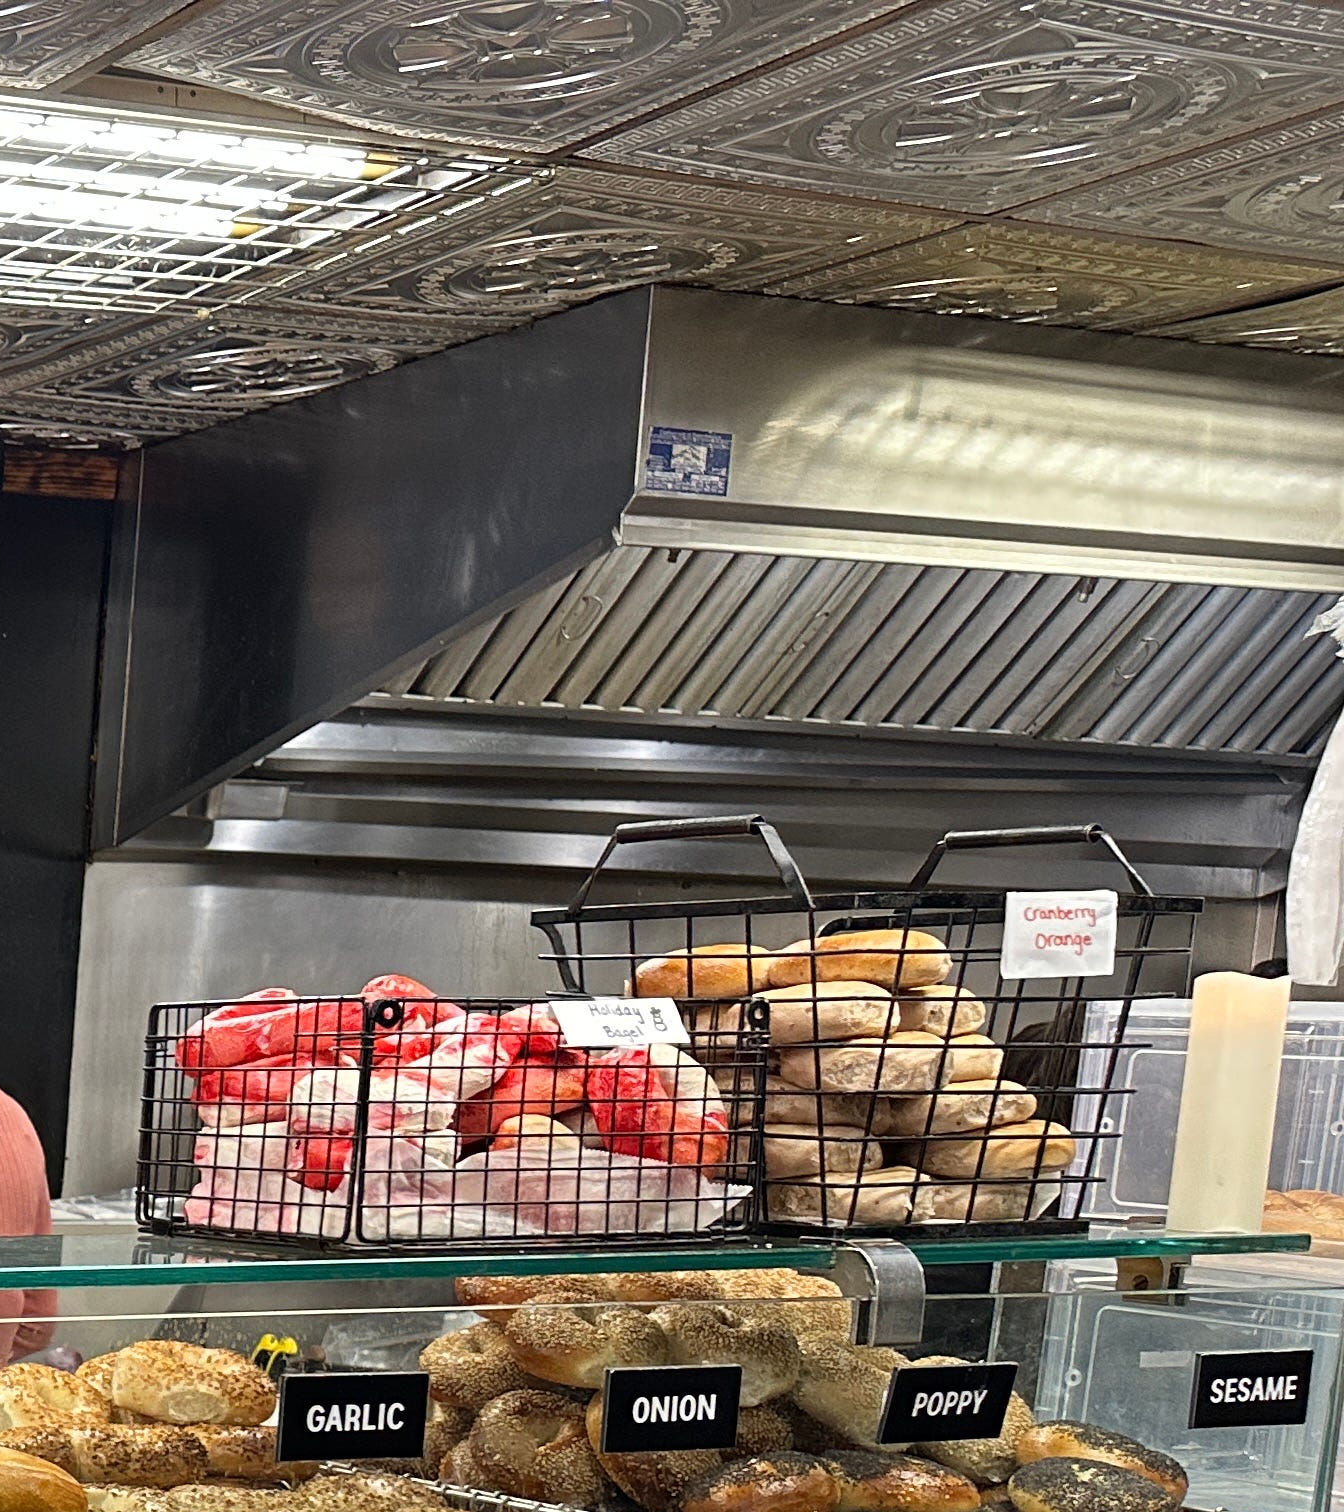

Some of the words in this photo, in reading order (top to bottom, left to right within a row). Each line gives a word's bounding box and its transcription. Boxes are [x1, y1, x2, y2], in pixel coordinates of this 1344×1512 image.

[1023, 906, 1097, 928] Cranberry
[1035, 933, 1093, 956] Orange
[588, 1004, 645, 1024] Holiday
[602, 1025, 644, 1043] Bagel
[1210, 1376, 1298, 1403] SESAME
[633, 1394, 716, 1423] ONION
[912, 1390, 987, 1416] POPPY
[307, 1403, 404, 1432] GARLIC
